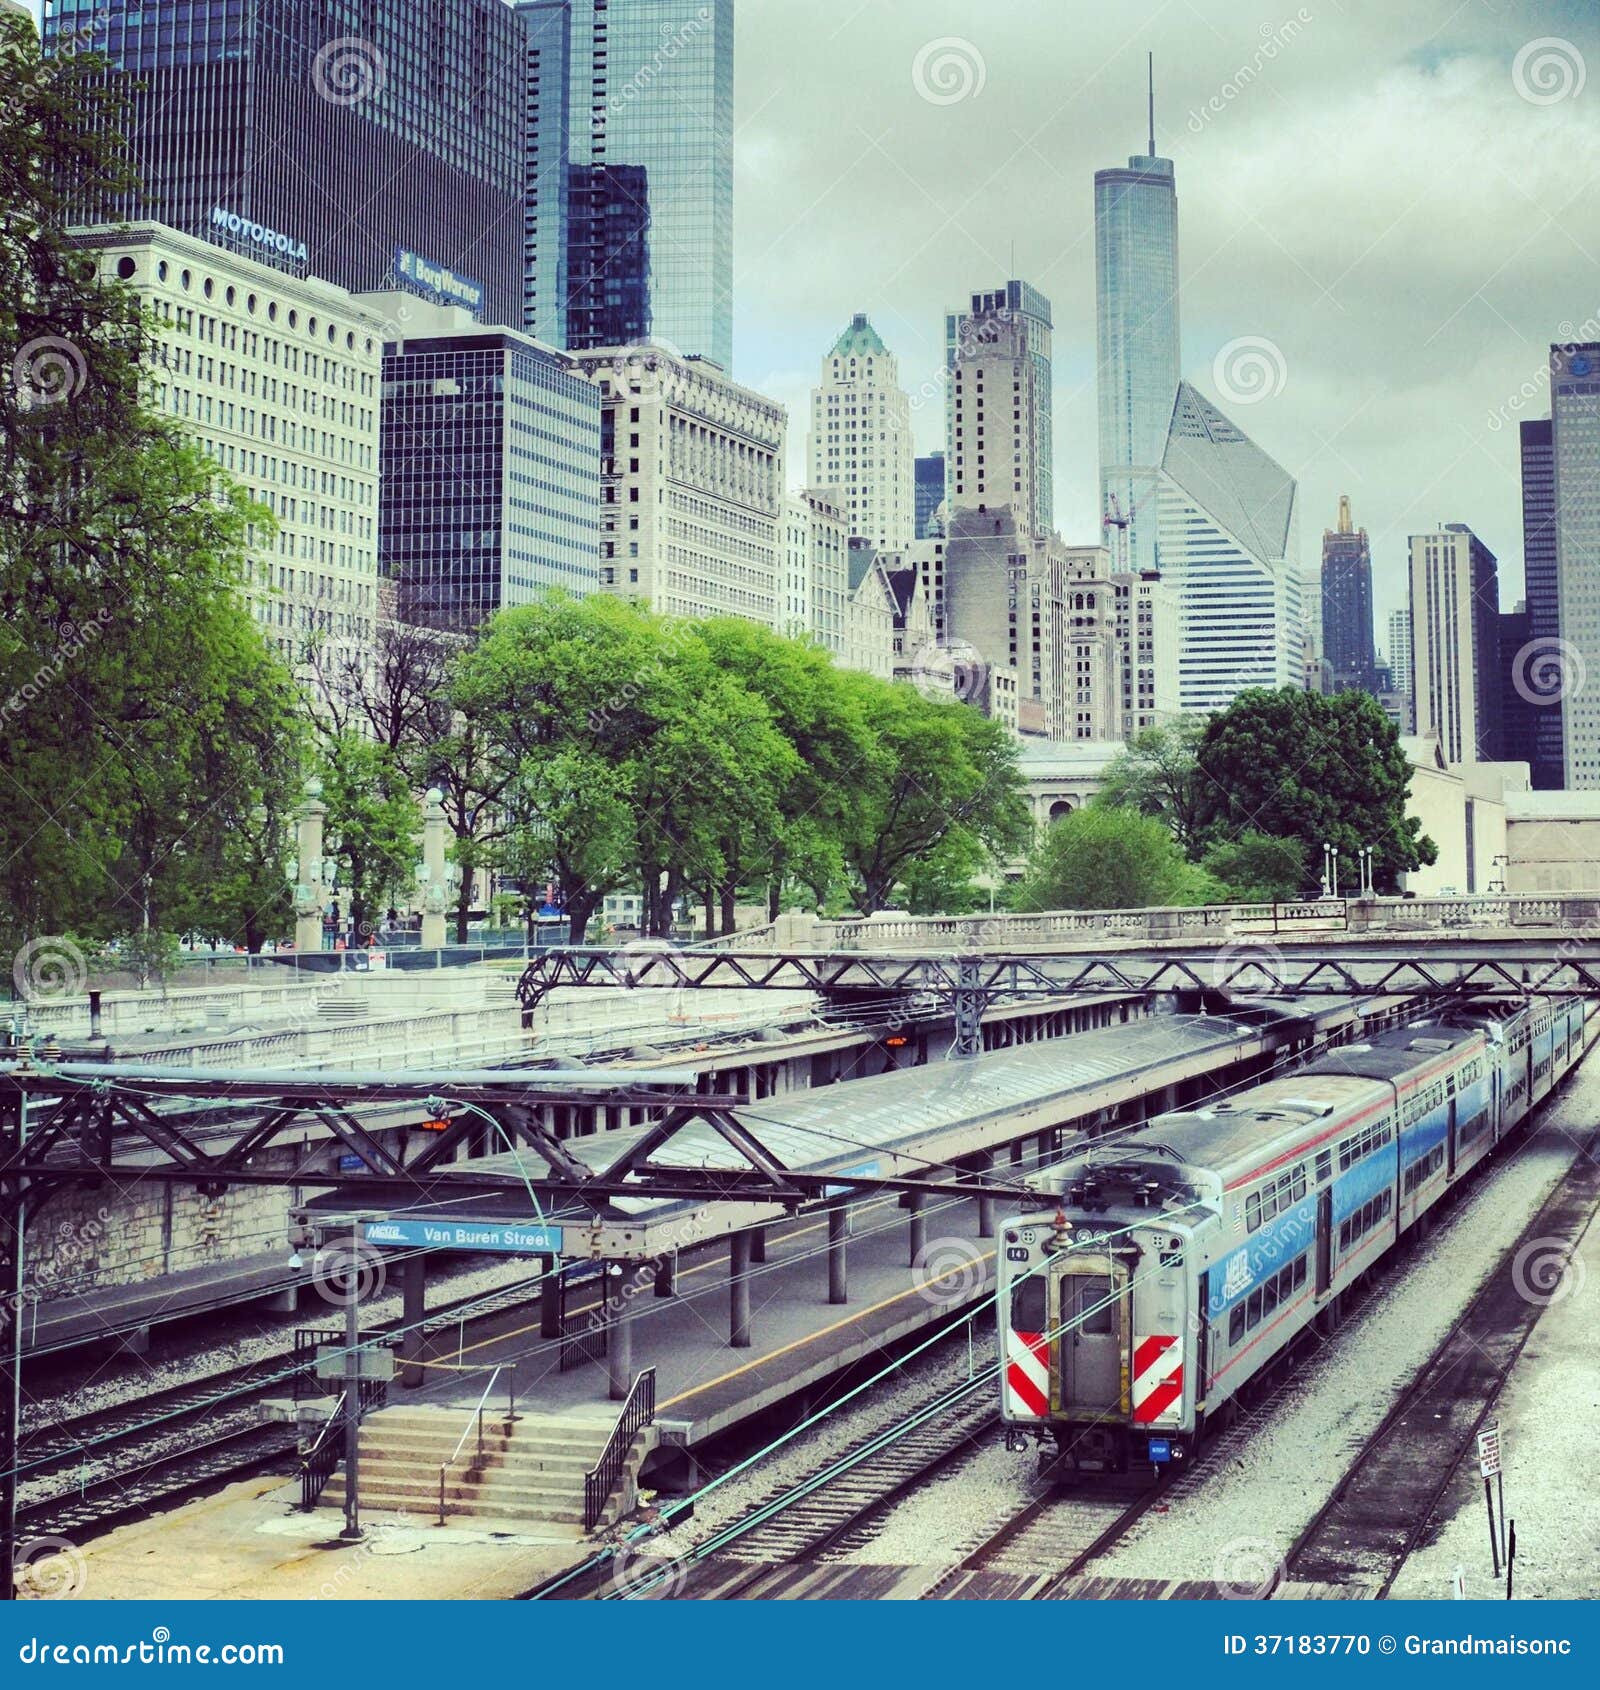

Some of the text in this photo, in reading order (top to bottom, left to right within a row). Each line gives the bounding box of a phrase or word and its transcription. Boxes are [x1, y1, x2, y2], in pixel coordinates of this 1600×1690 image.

[211, 207, 308, 261] MOTOROLA
[415, 257, 481, 305] BorgWarner
[424, 1227, 450, 1241] Van
[456, 1229, 499, 1244] Buren
[504, 1230, 551, 1246] Street
